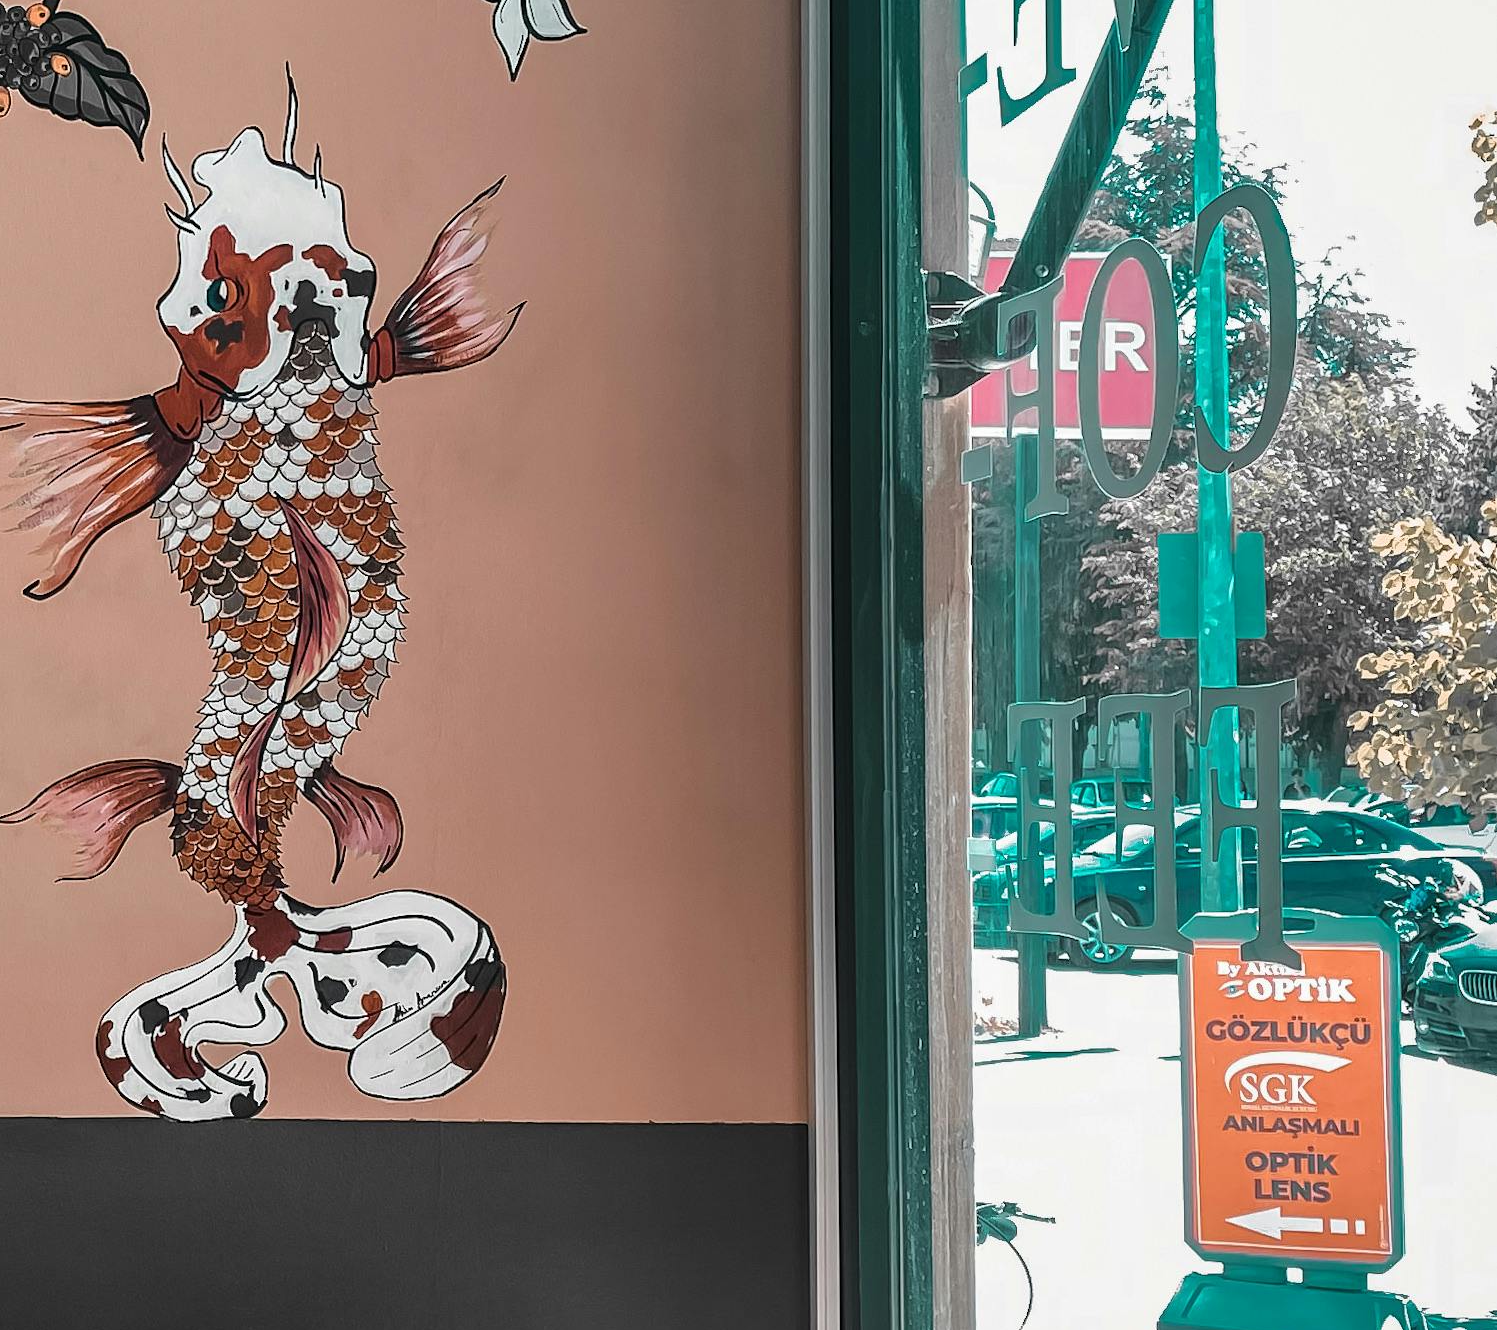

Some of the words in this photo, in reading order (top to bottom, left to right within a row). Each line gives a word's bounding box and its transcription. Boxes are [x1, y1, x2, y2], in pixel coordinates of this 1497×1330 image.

[1216, 961, 1241, 977] By
[1206, 1014, 1370, 1050] GÖZLÜKÇÜ
[1239, 1073, 1317, 1105] SGK
[1223, 1116, 1360, 1139] ANLAŞMALI
[1245, 1145, 1339, 1176] OPTİK
[1255, 1179, 1332, 1202] LENS
